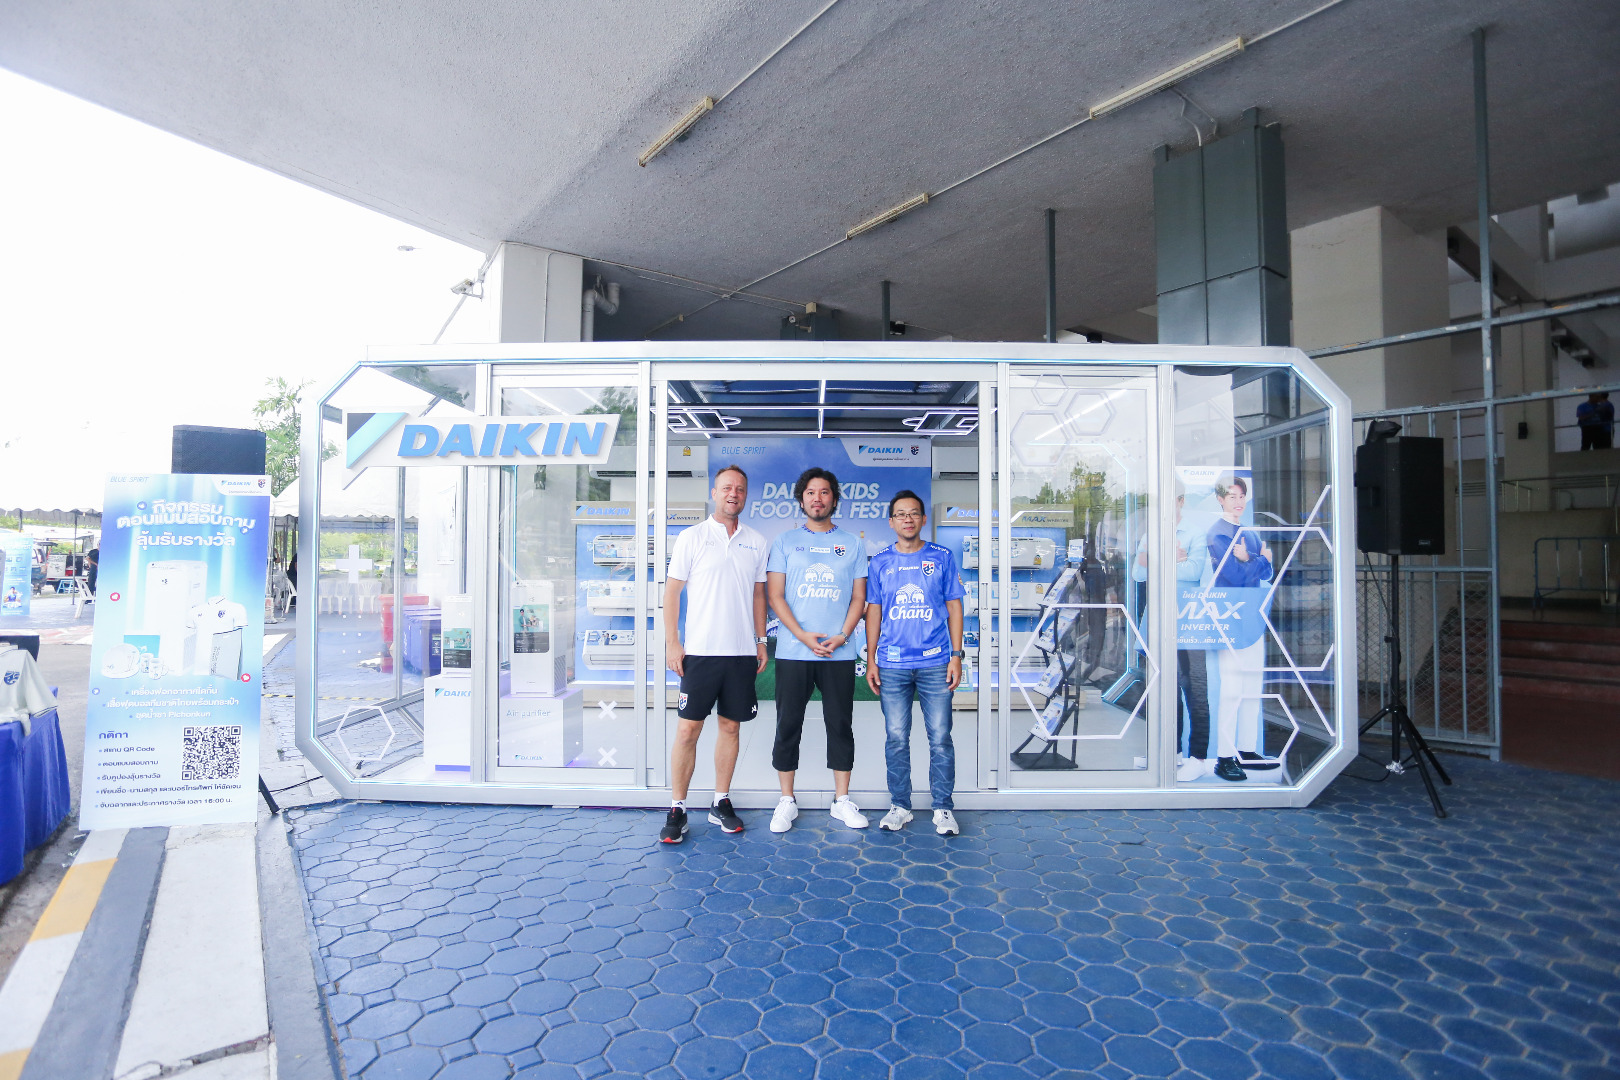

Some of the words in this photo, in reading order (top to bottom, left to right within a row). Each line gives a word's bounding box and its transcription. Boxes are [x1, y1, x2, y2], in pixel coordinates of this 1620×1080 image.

[397, 422, 607, 457] DAIKIN
[721, 446, 741, 454] BLUE
[742, 446, 767, 454] SPIRIT
[762, 482, 797, 500] DAI
[838, 482, 880, 500] KIDS
[152, 500, 223, 514] กิจกรรม
[586, 508, 631, 516] DAIKIN
[750, 502, 843, 518] FOOTLL
[850, 502, 890, 518] FEST
[116, 513, 256, 530] ตอบแบบสอบถาม
[136, 530, 236, 550] ลุ้นรับรางวัล
[796, 584, 842, 602] Chang
[888, 606, 933, 622] Chang
[1176, 602, 1246, 620] MAX
[521, 710, 551, 718] purifier
[98, 730, 128, 739] กติกา
